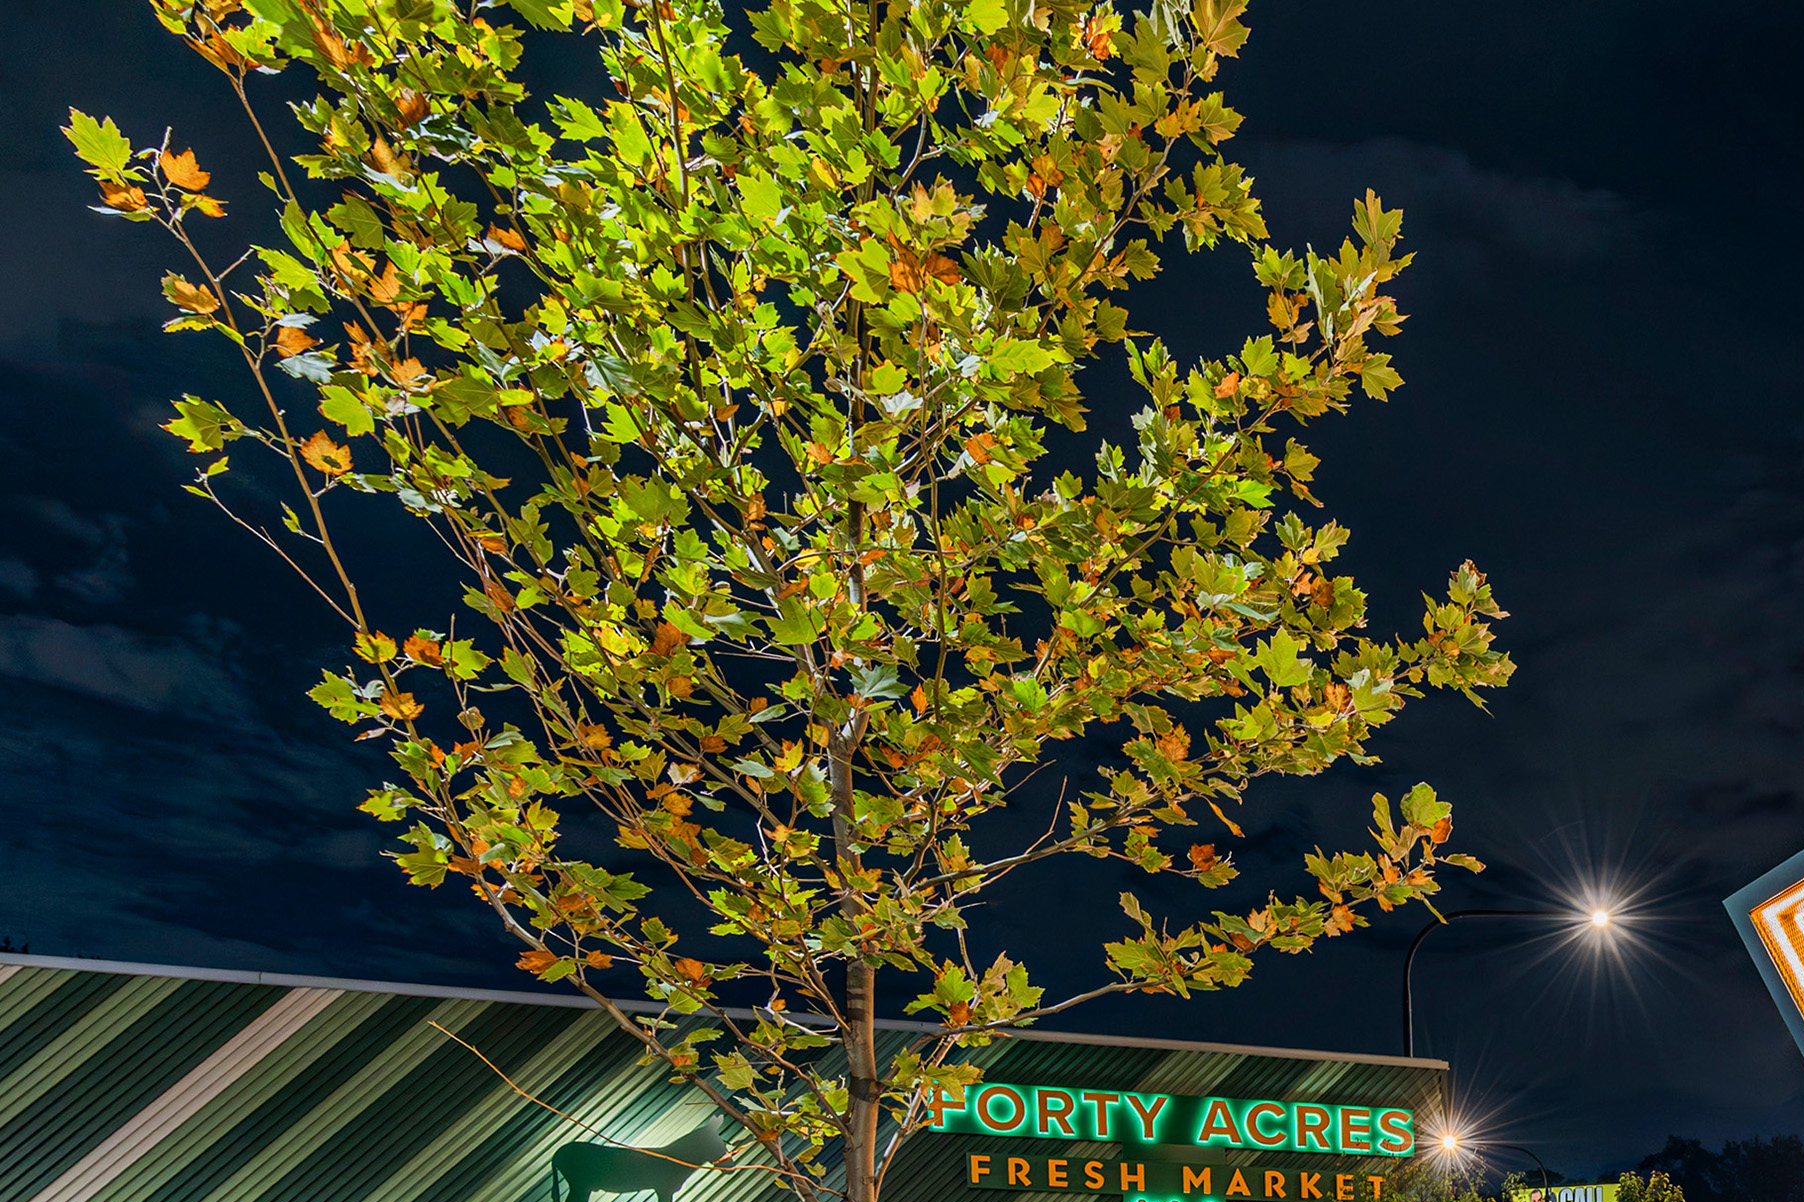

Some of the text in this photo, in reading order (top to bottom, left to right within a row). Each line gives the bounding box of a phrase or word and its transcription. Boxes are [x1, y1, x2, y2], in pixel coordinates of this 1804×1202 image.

[932, 1083, 1414, 1152] FORTY ACRES
[970, 1155, 1386, 1201] FRESH MARKET
